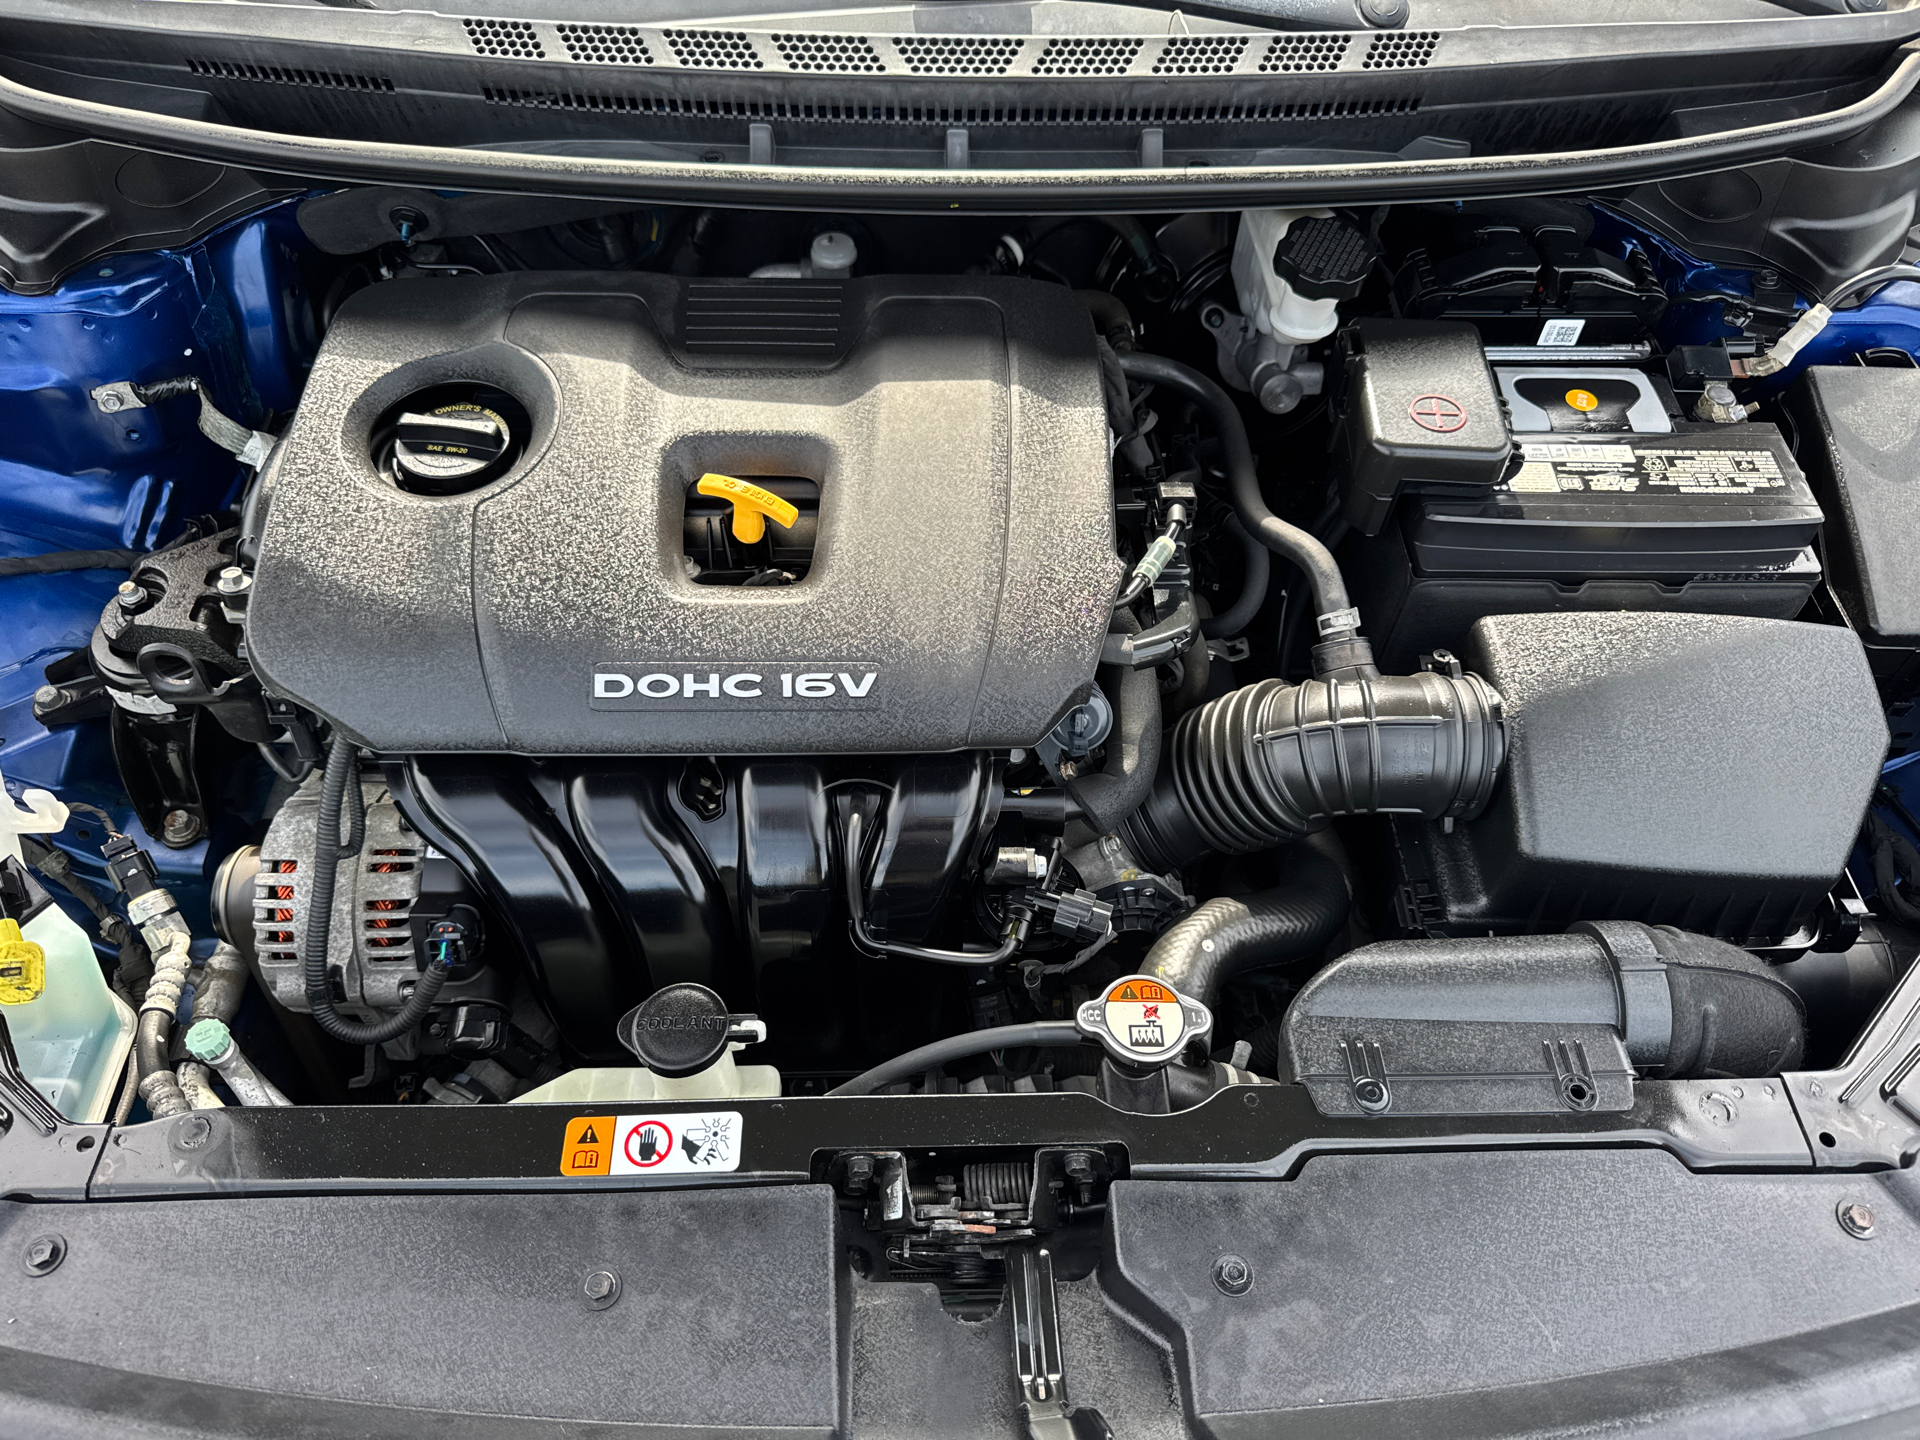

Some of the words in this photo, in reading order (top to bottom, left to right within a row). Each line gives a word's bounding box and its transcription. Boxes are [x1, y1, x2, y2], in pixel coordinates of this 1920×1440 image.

[435, 404, 481, 415] OWNER'S
[427, 444, 443, 452] SAE
[446, 446, 468, 454] 5W-20
[593, 672, 763, 699] DOHC
[781, 672, 878, 699] 16V
[636, 1015, 725, 1031] COOLANT
[1081, 1009, 1101, 1021] HCC
[1191, 1011, 1206, 1023] 1.1
